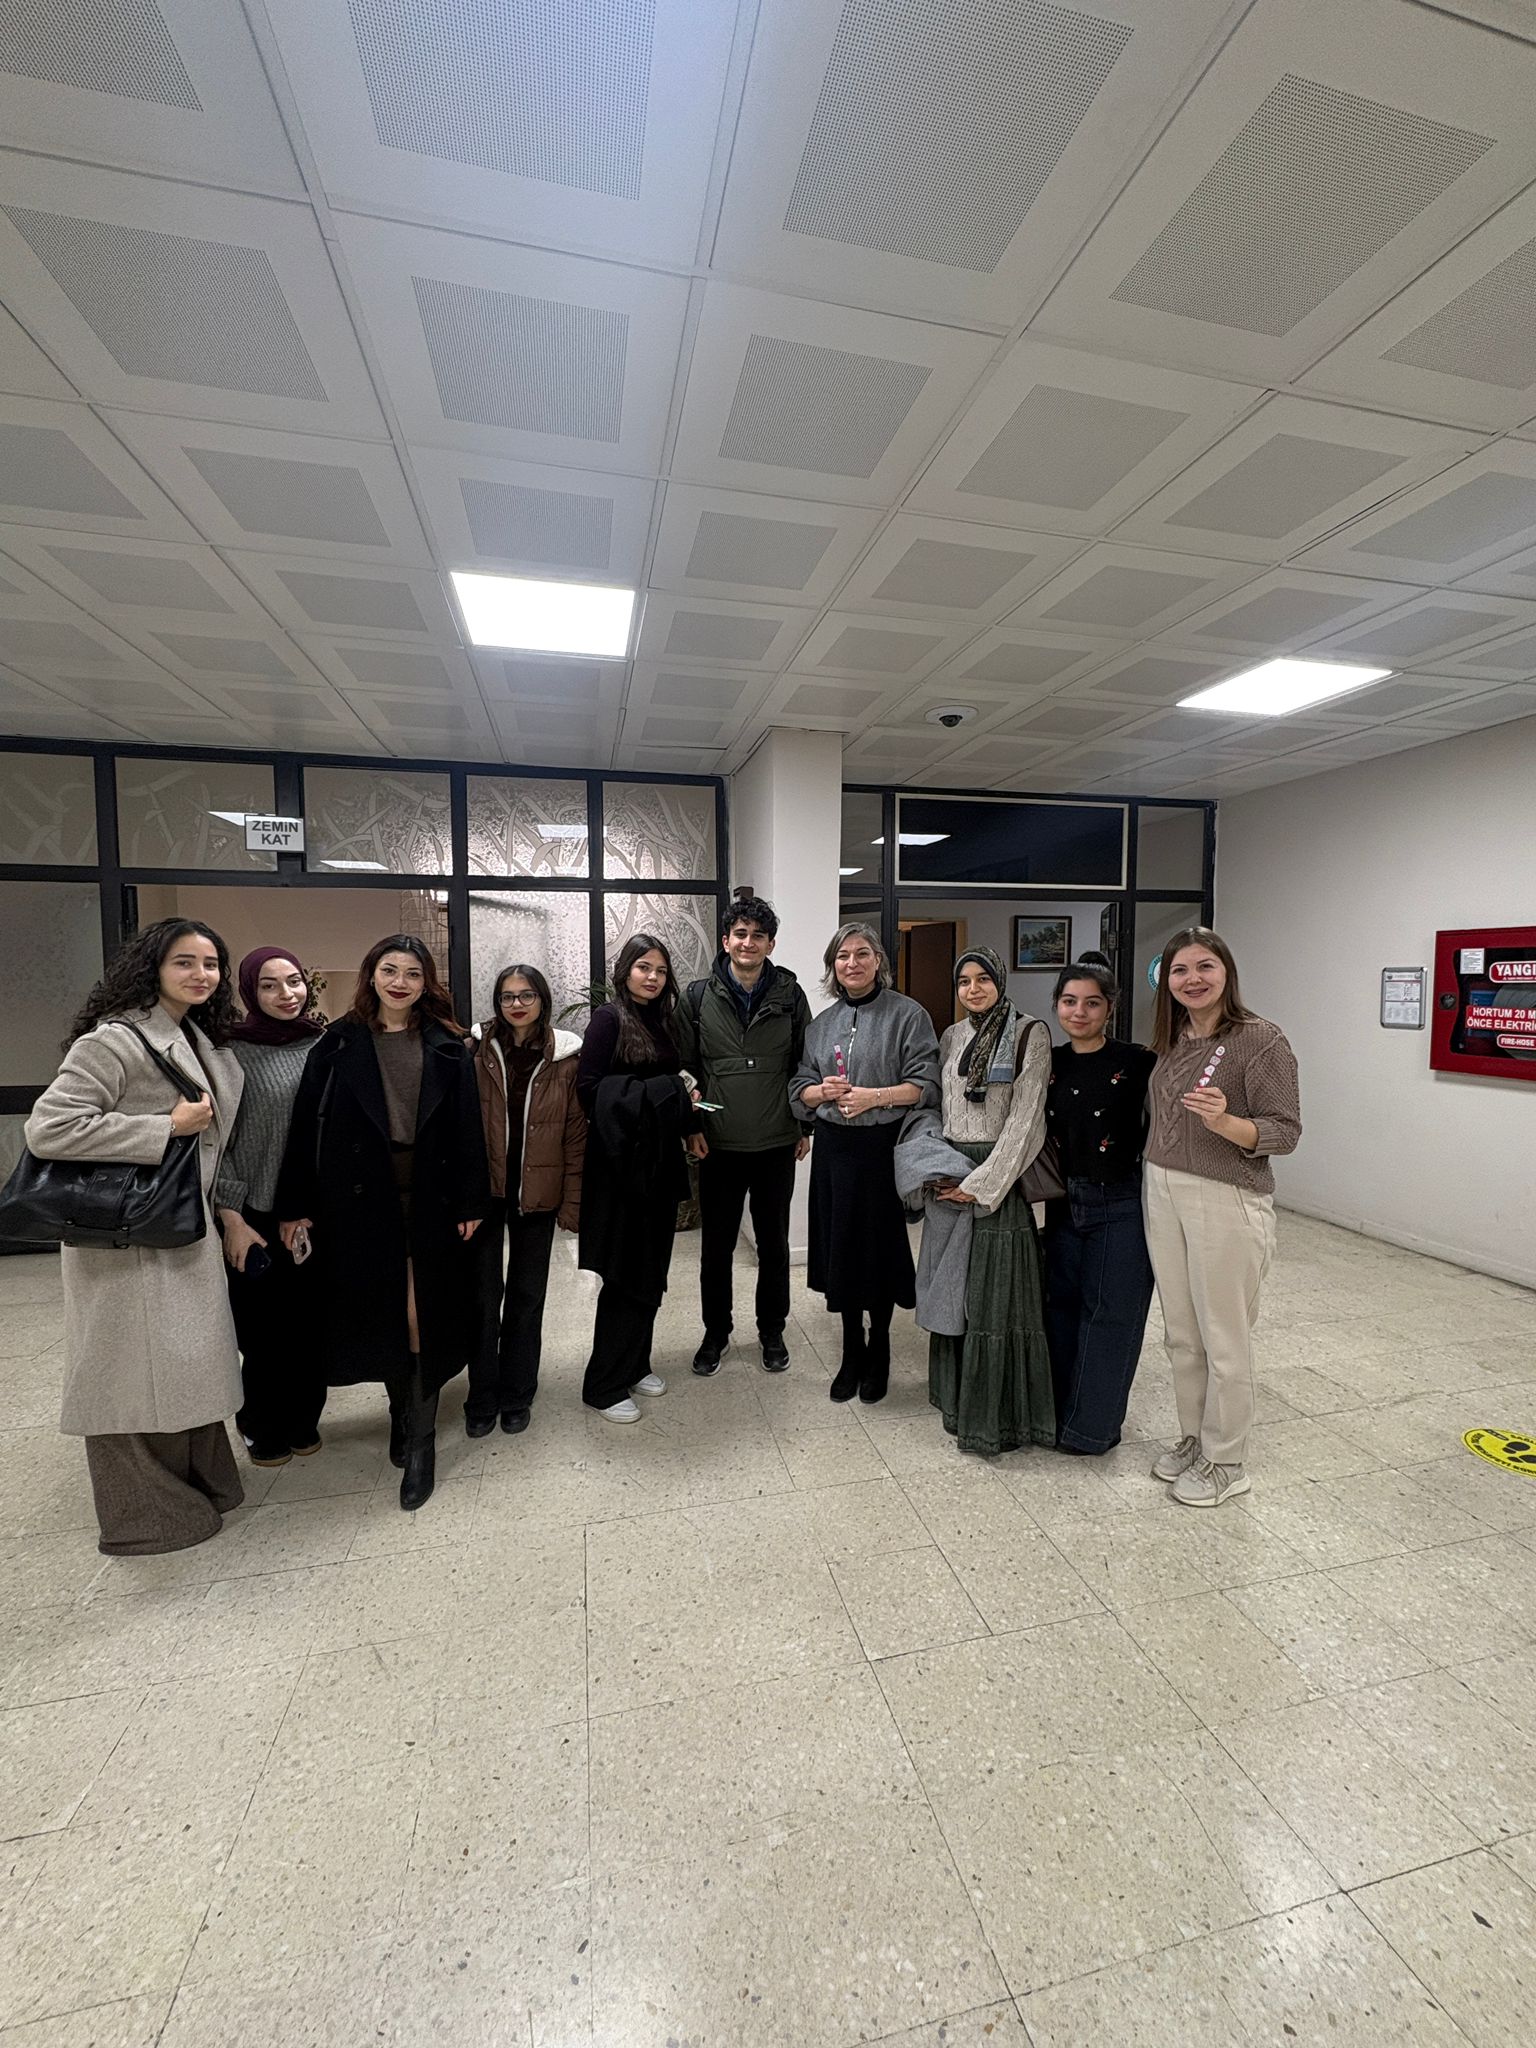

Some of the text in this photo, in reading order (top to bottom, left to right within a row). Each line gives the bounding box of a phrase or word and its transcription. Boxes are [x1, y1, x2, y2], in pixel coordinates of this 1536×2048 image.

[261, 834, 291, 845] KAT
[1473, 1008, 1512, 1018] HORTUM
[1514, 1010, 1525, 1019] 20
[1466, 1017, 1536, 1031] ÖNCE ELEKTRİ
[1501, 1038, 1535, 1046] FIRE-HOSE
